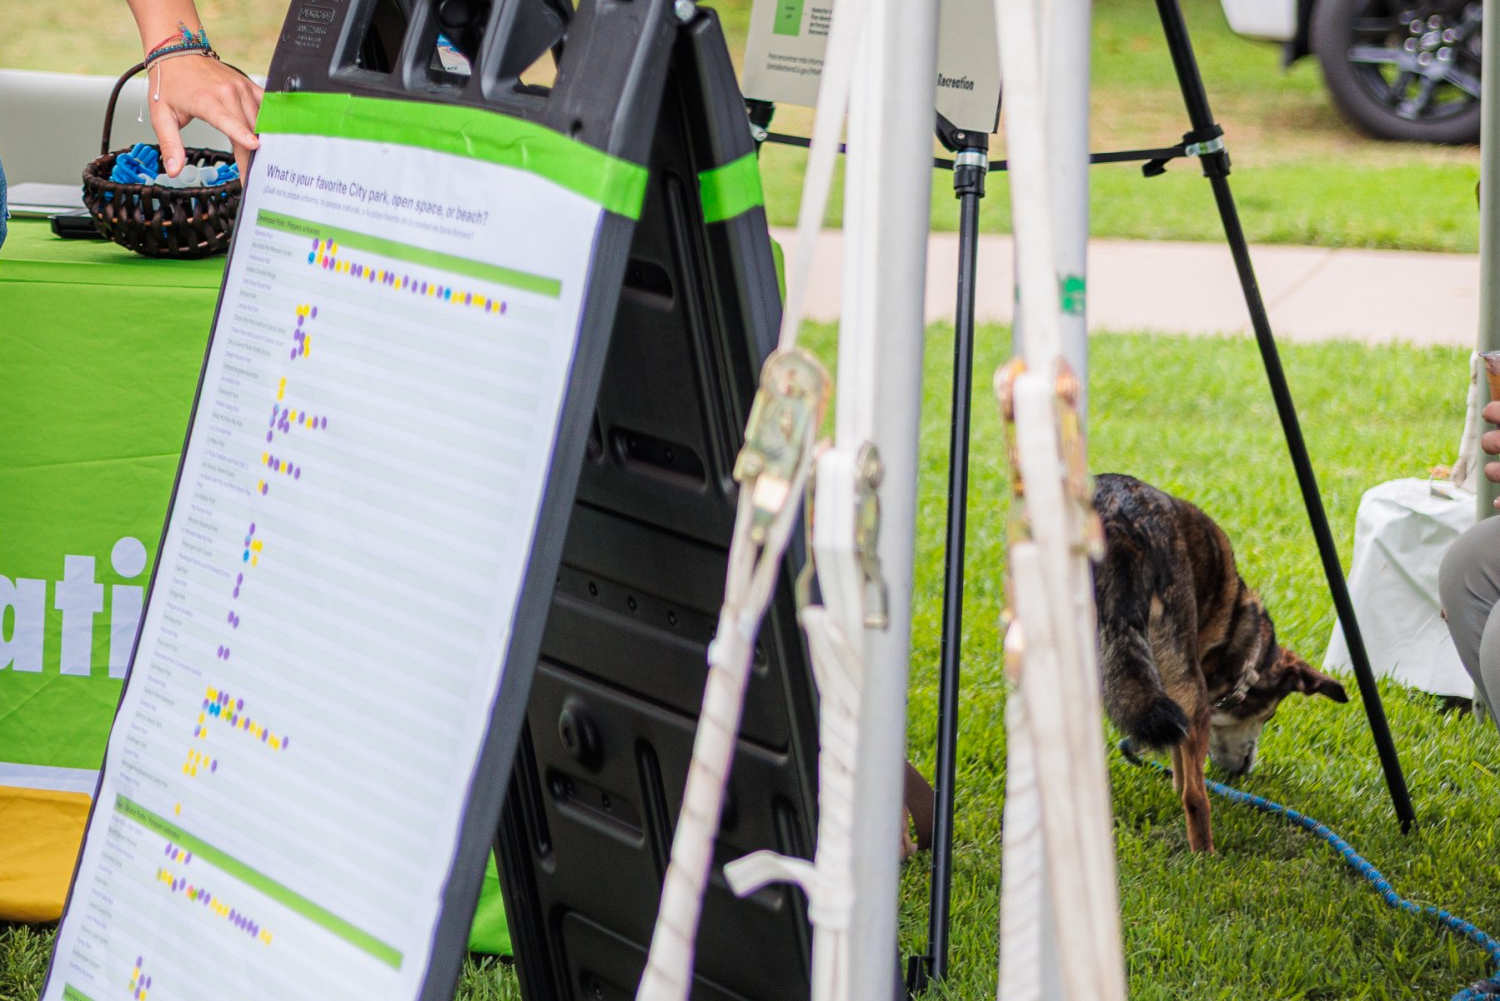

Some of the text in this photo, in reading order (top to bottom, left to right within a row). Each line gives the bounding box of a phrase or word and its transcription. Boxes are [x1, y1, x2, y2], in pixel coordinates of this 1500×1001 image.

[267, 164, 489, 226] What is your favorite City park, open space, or beach?
